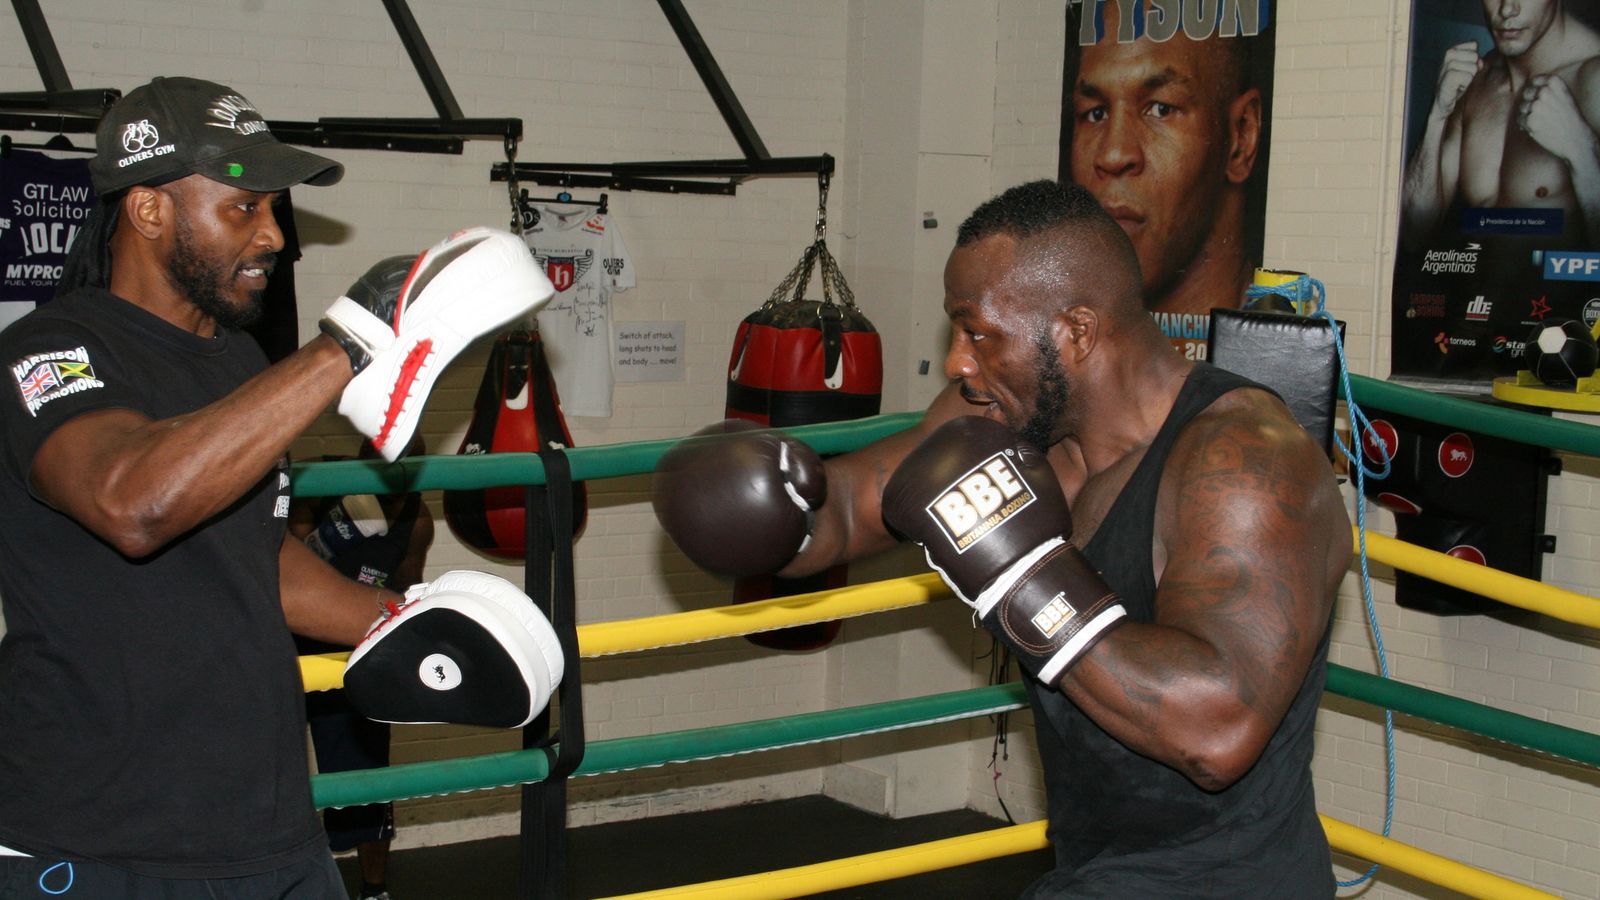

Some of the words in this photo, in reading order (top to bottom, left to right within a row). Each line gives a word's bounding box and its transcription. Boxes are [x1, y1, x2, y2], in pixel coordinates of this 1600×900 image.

[118, 149, 154, 168] OLIVERS
[154, 144, 176, 156] GYM
[23, 183, 89, 203] GTLAW
[1424, 249, 1478, 263] Aerolíneas
[1421, 260, 1476, 275] Argentinas
[1550, 257, 1600, 275] YPF
[4, 279, 26, 287] FUEL
[619, 331, 642, 340] Switch
[1449, 337, 1476, 347] torneos
[619, 344, 633, 354] long
[661, 344, 677, 352] head
[12, 346, 90, 384] HARRISON
[618, 357, 631, 365] and
[632, 357, 649, 366] body
[26, 377, 105, 418] PROMOTIONS
[934, 458, 1023, 538] BBE
[957, 513, 1003, 549] BRITANNIA
[1001, 492, 1031, 518] BOXING
[1035, 597, 1071, 633] BBE
